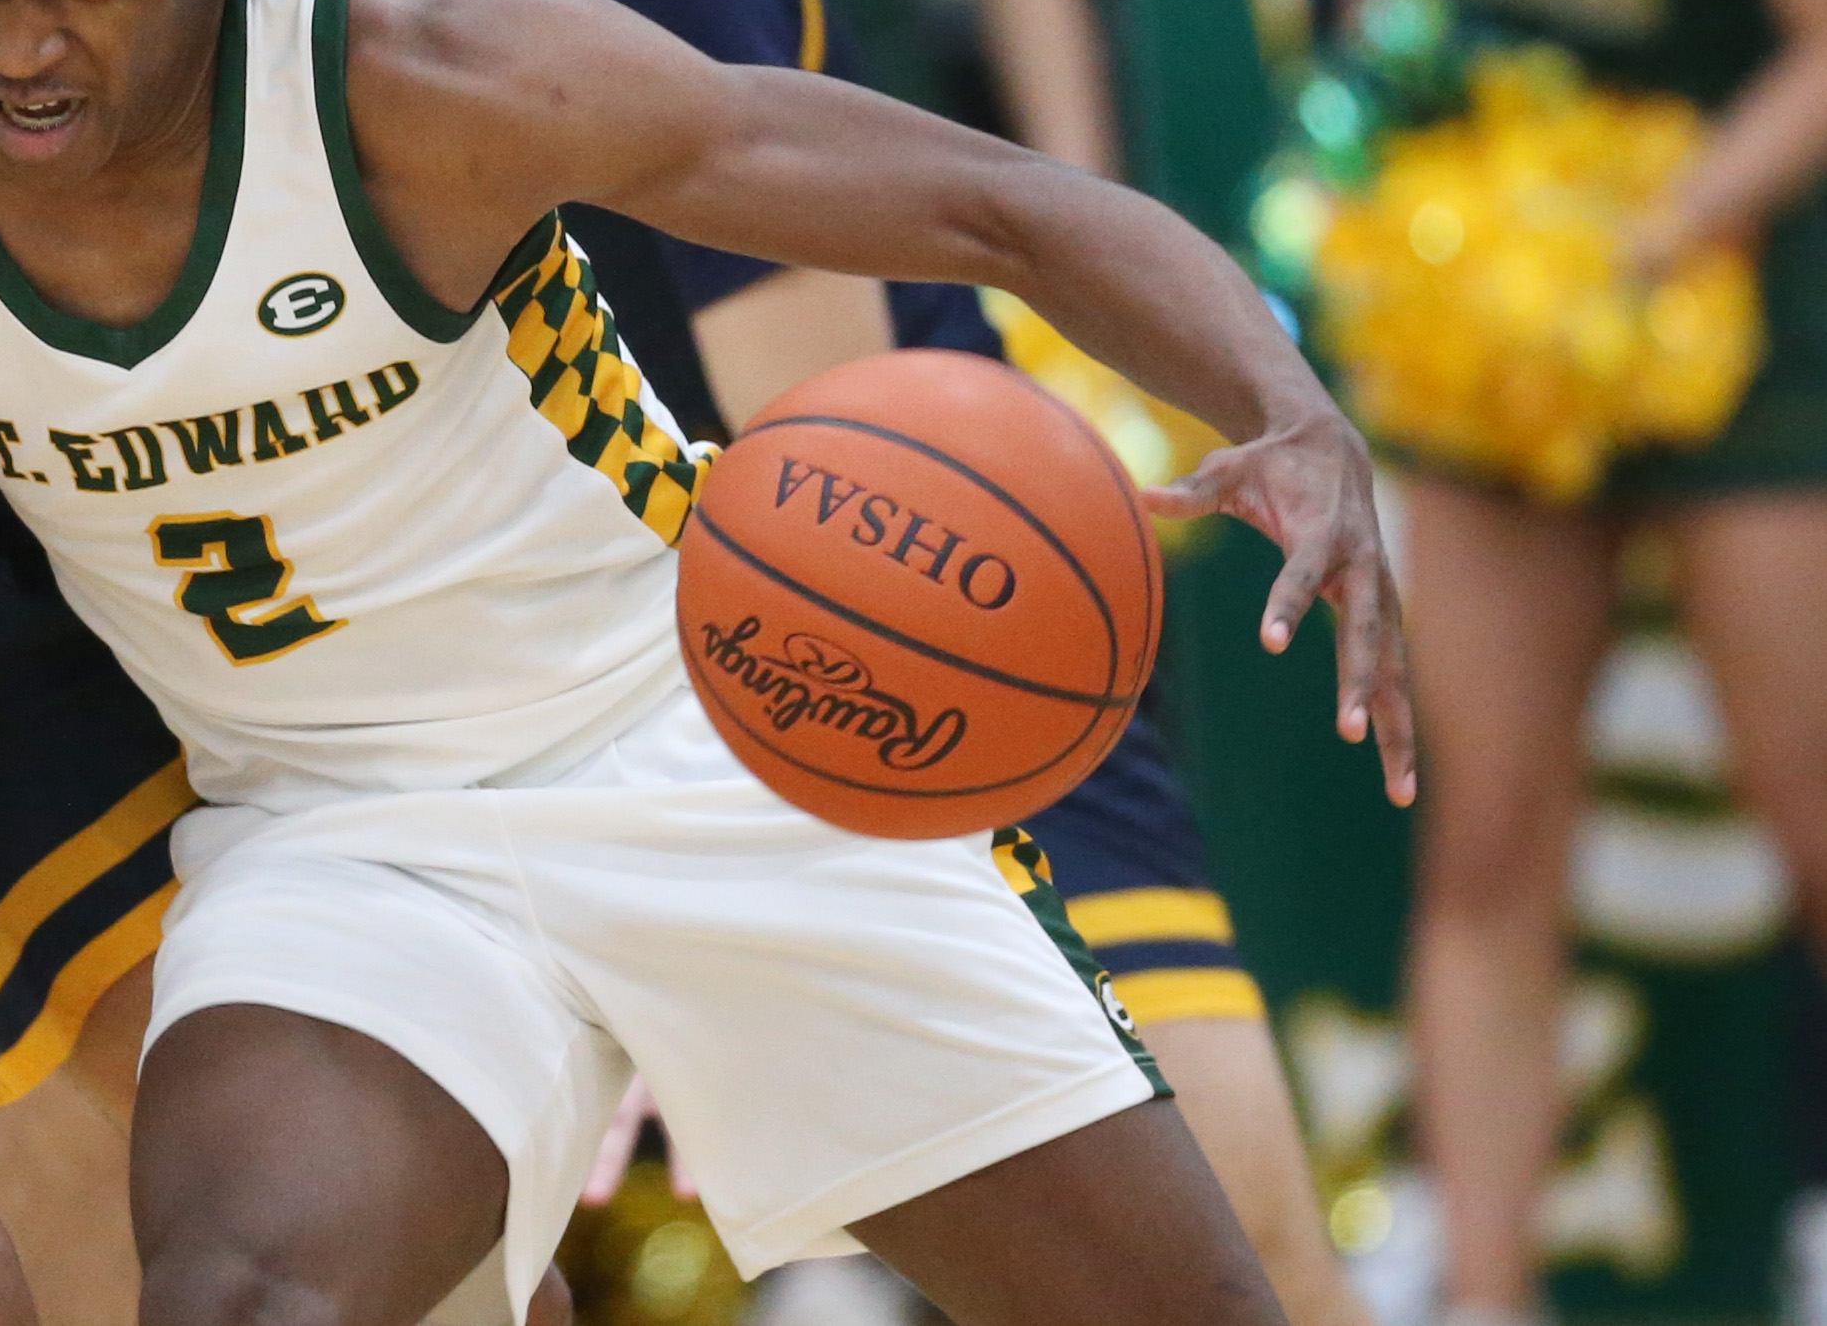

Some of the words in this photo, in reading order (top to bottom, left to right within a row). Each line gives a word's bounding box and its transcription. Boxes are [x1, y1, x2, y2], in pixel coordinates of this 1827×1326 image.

[47, 359, 421, 494] EDWARD
[144, 508, 350, 668] 2
[774, 457, 1017, 611] OHSAA
[701, 614, 969, 772] Rawlings
